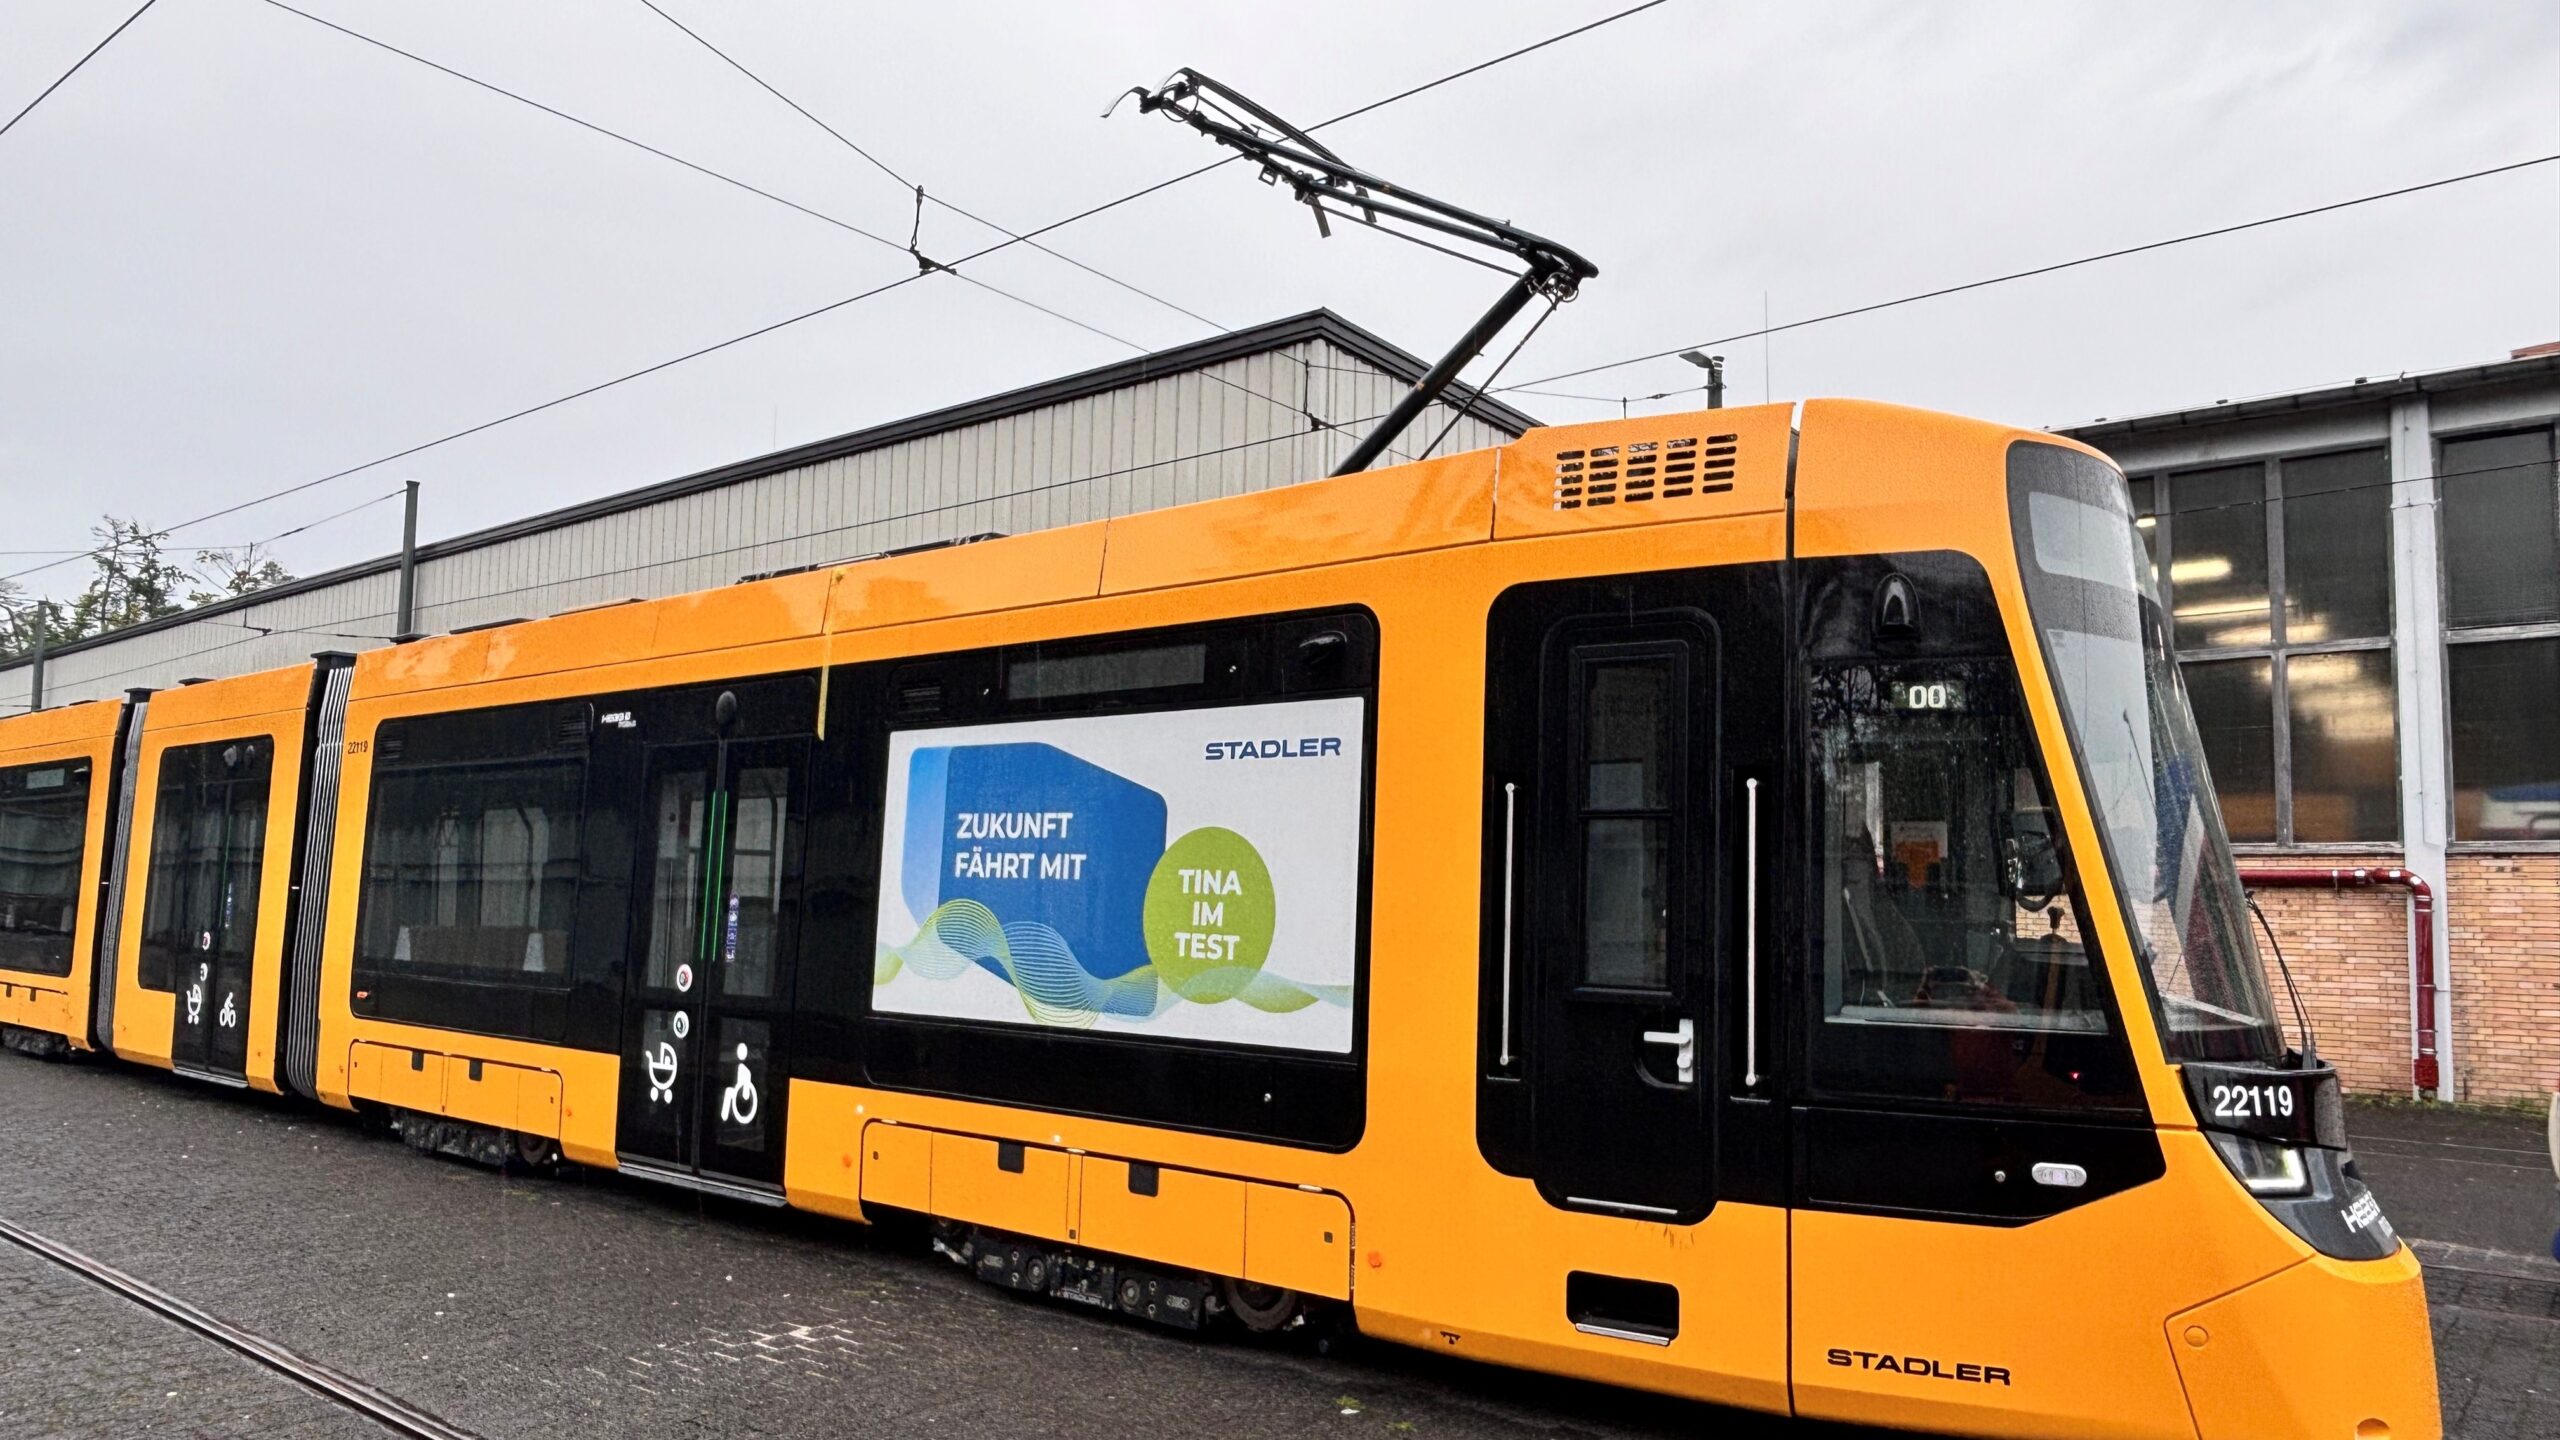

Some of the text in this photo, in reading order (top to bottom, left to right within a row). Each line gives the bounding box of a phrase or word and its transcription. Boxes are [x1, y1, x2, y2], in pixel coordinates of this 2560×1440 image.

[1205, 737, 1342, 760] STADLER
[956, 811, 1074, 839] ZUKUNFT
[954, 845, 1087, 880] FÄHRT MIT
[1178, 868, 1243, 896] TINA
[1192, 901, 1224, 928] IM
[1174, 931, 1241, 961] TEST
[2212, 1085, 2294, 1117] 22119
[1826, 1348, 2012, 1387] STADLER
